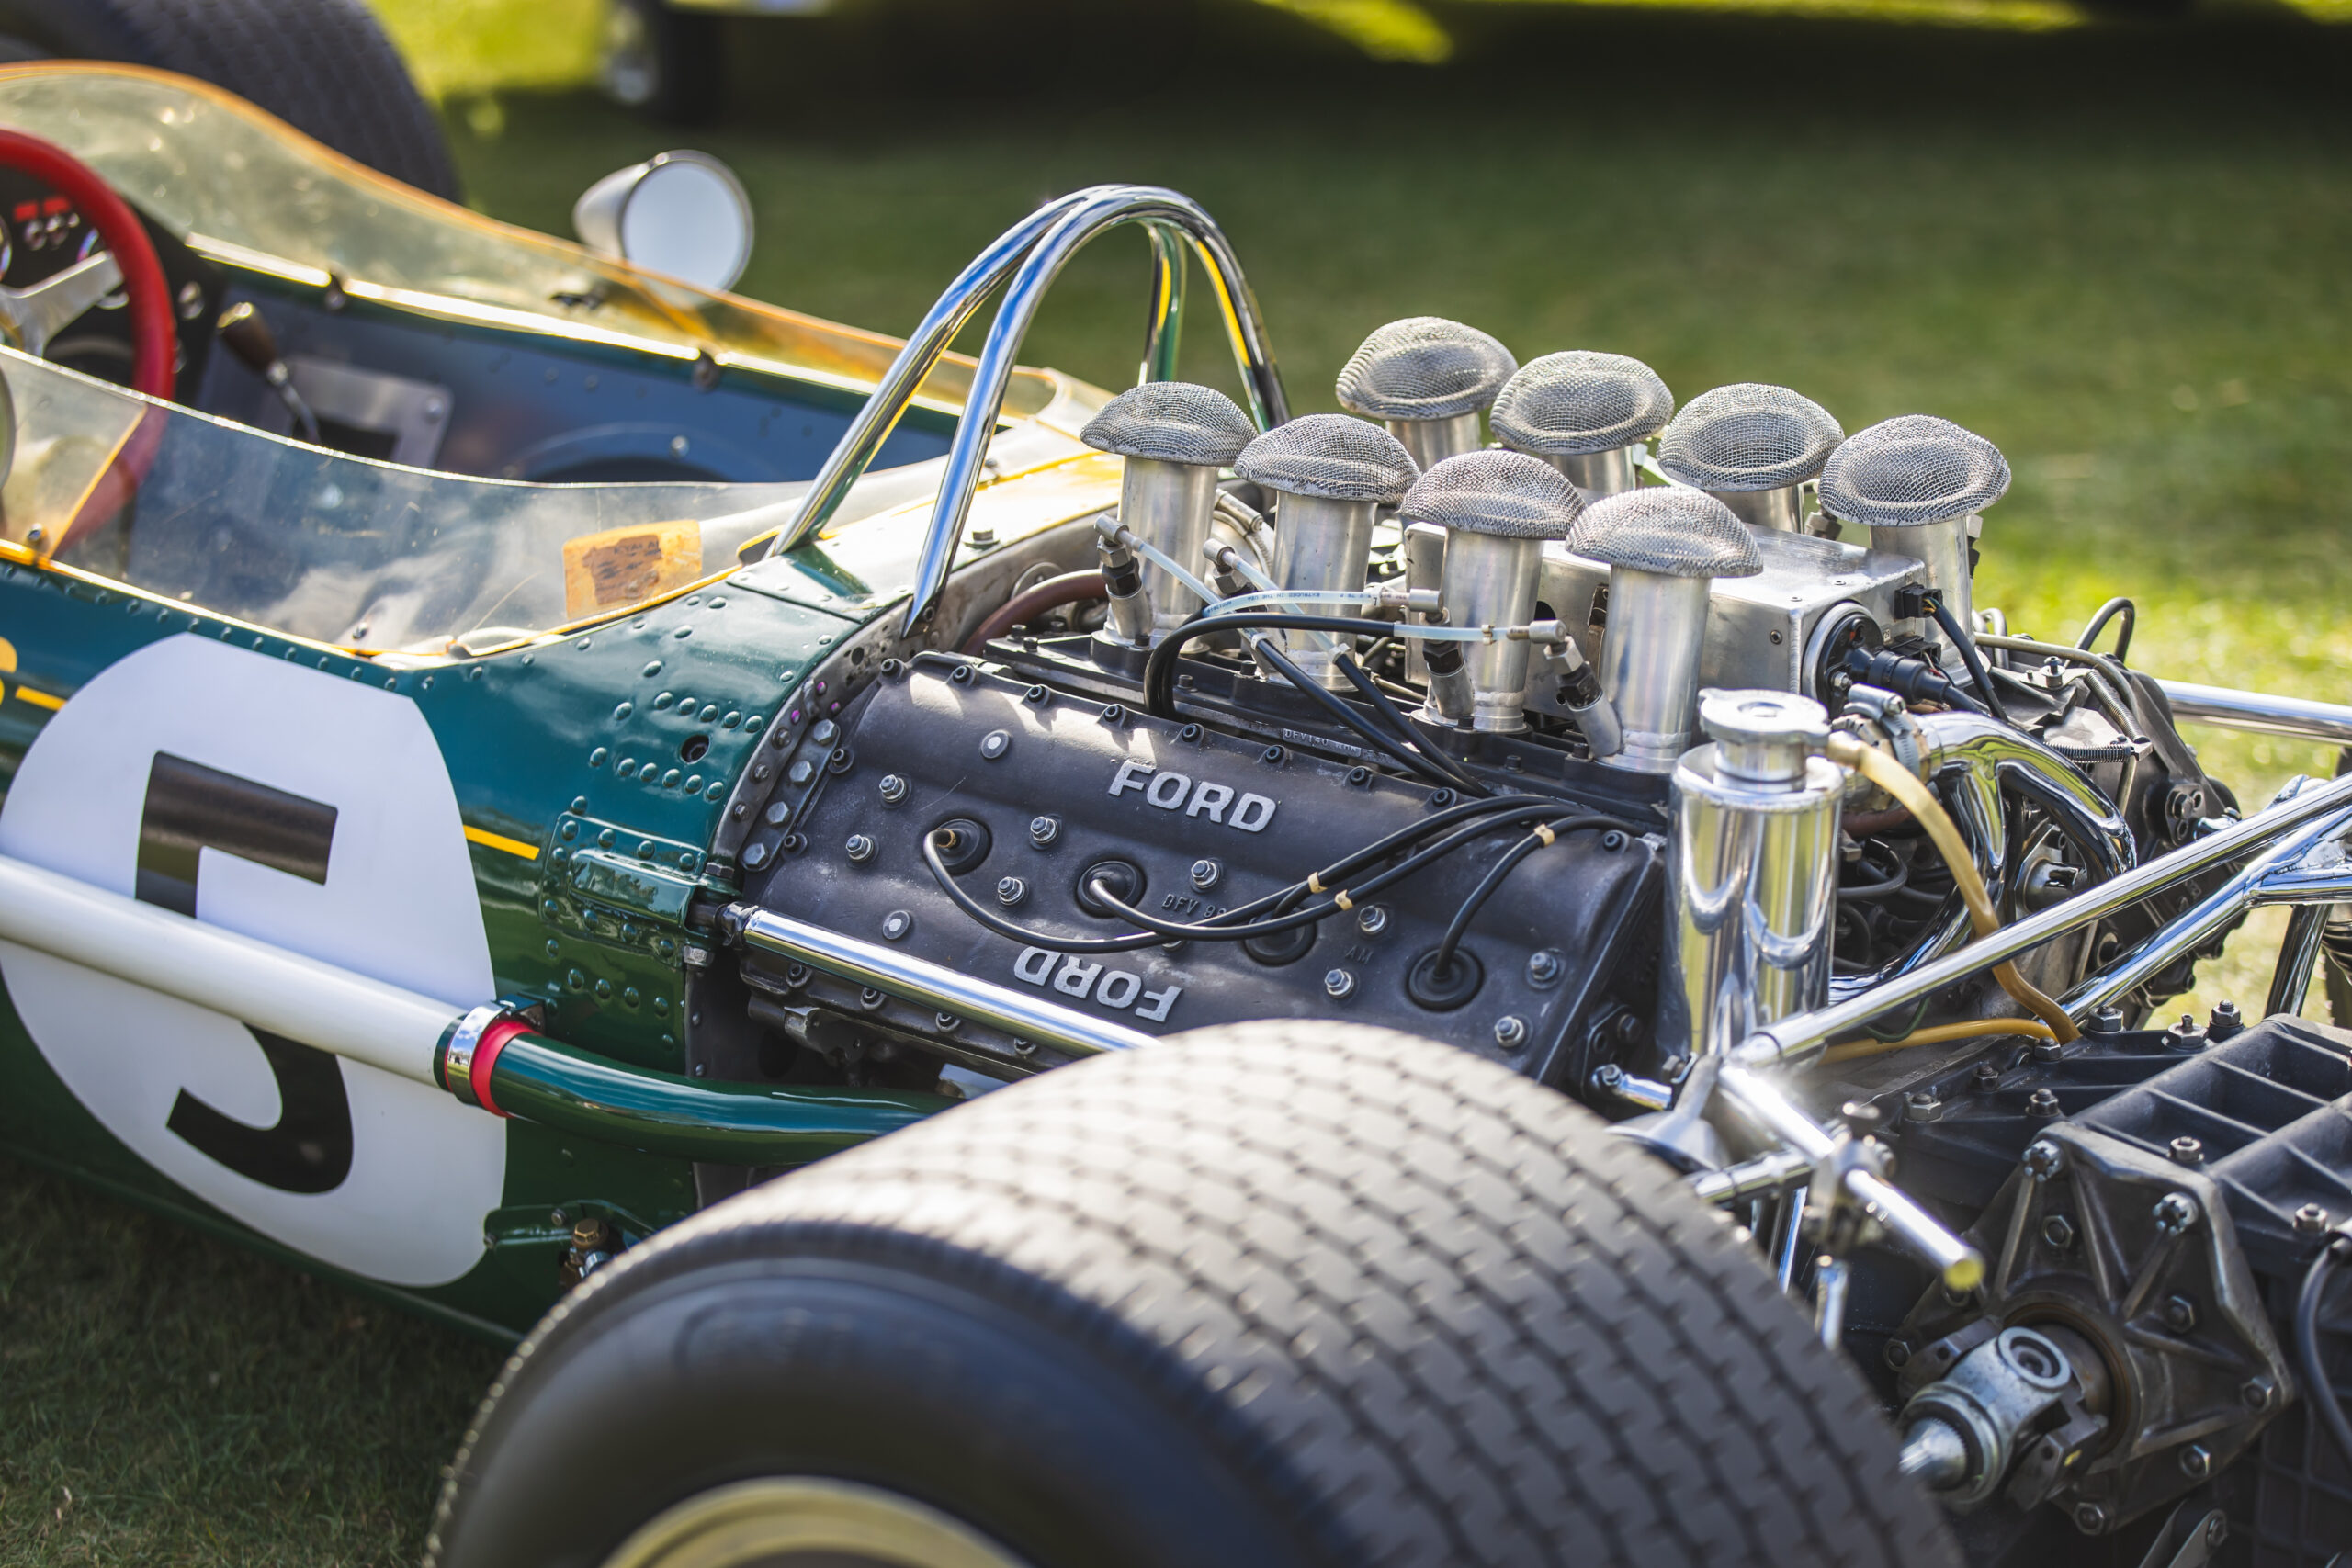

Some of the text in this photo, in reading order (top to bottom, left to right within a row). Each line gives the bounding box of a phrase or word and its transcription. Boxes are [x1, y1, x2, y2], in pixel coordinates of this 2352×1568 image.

[1108, 759, 1277, 833] FORD
[1161, 893, 1200, 915] DFV
[135, 750, 355, 1195] 5
[1013, 946, 1182, 1022] FORD
